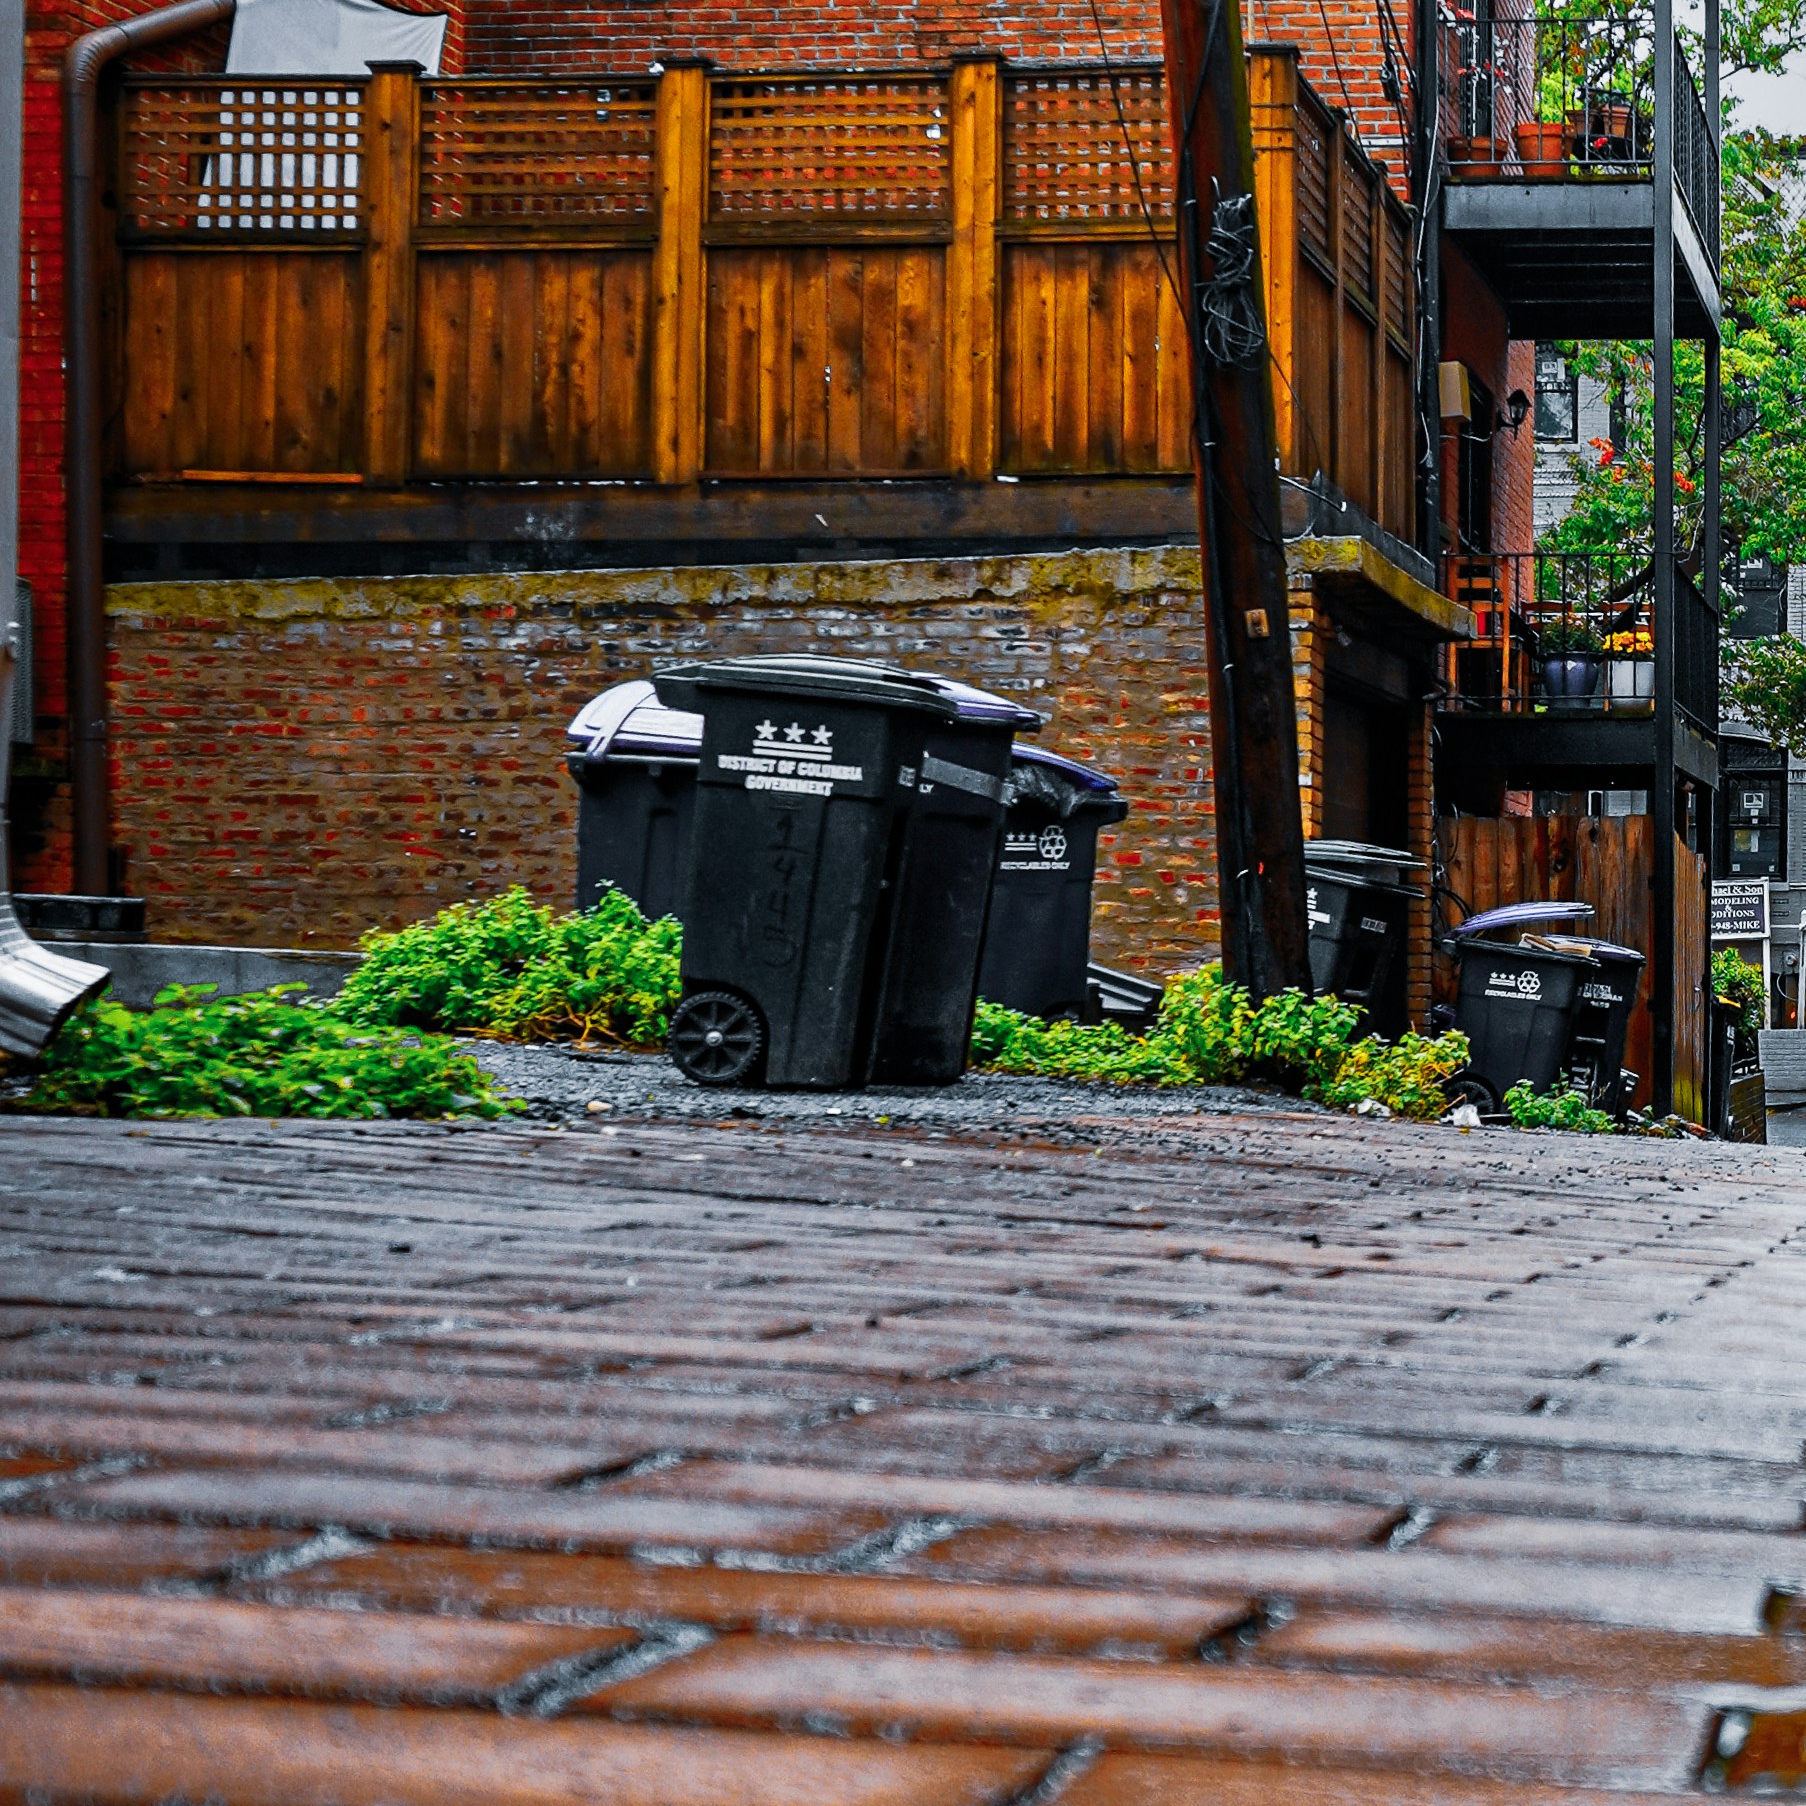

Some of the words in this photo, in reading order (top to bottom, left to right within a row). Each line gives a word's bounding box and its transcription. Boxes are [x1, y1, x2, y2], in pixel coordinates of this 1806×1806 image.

[718, 754, 777, 774] DISTRICT
[777, 759, 797, 775] OF
[797, 761, 863, 781] COLUMBIA
[745, 775, 834, 797] GOVERNMENT
[1744, 885, 1763, 895] Son
